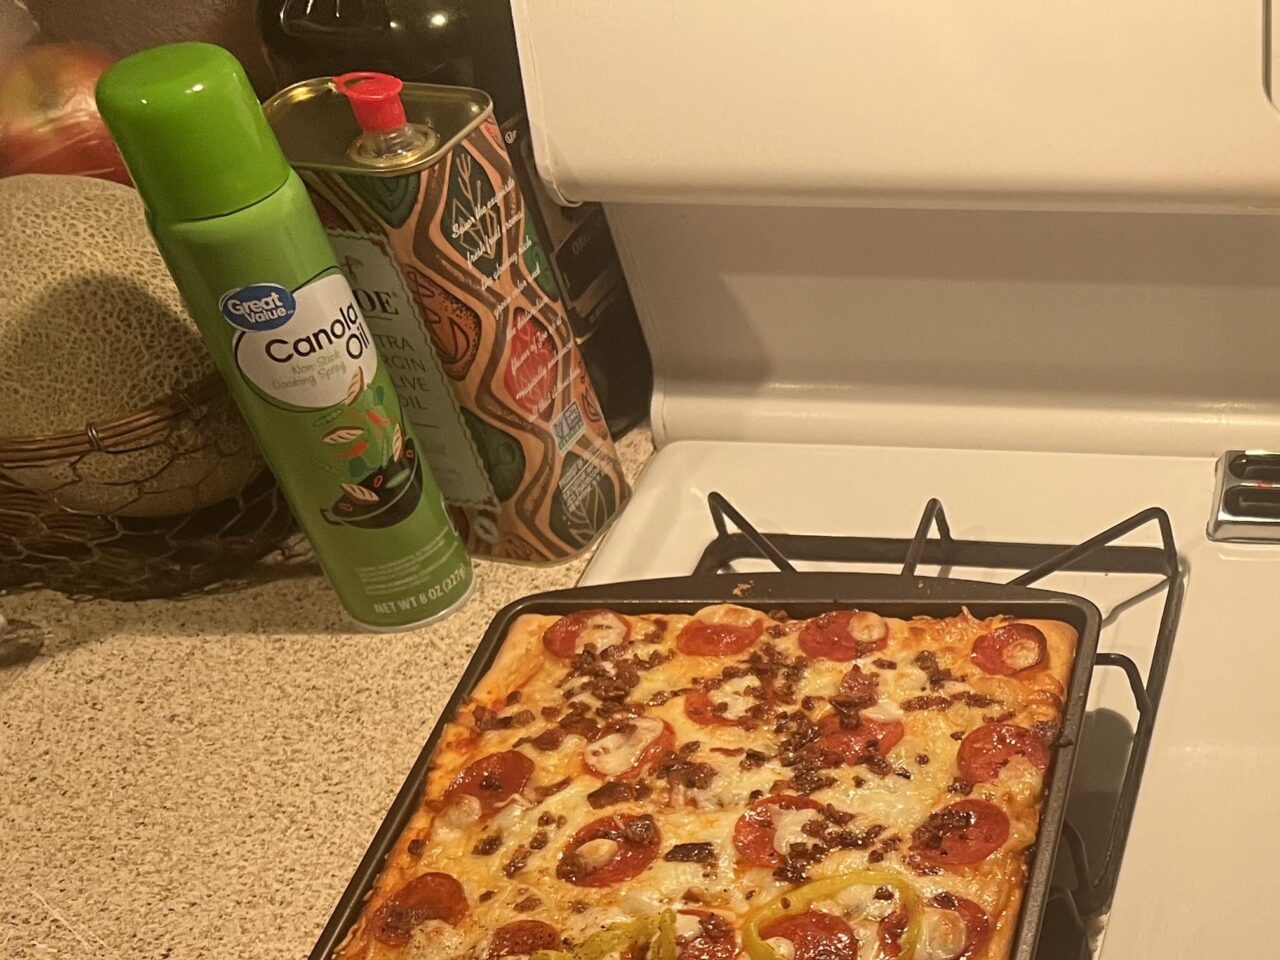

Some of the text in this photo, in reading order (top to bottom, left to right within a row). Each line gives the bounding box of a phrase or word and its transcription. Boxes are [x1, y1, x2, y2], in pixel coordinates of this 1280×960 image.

[227, 292, 283, 315] Great
[352, 288, 399, 315] OE
[244, 307, 287, 324] Value
[264, 302, 359, 363] Canola
[346, 322, 370, 360] Oil
[372, 334, 415, 352] TRA
[271, 361, 346, 390] Cooking Spray
[291, 350, 341, 374] Non-Stick
[373, 601, 397, 614] NET
[397, 596, 418, 611] WT
[418, 592, 429, 605] 8
[428, 585, 443, 600] OZ
